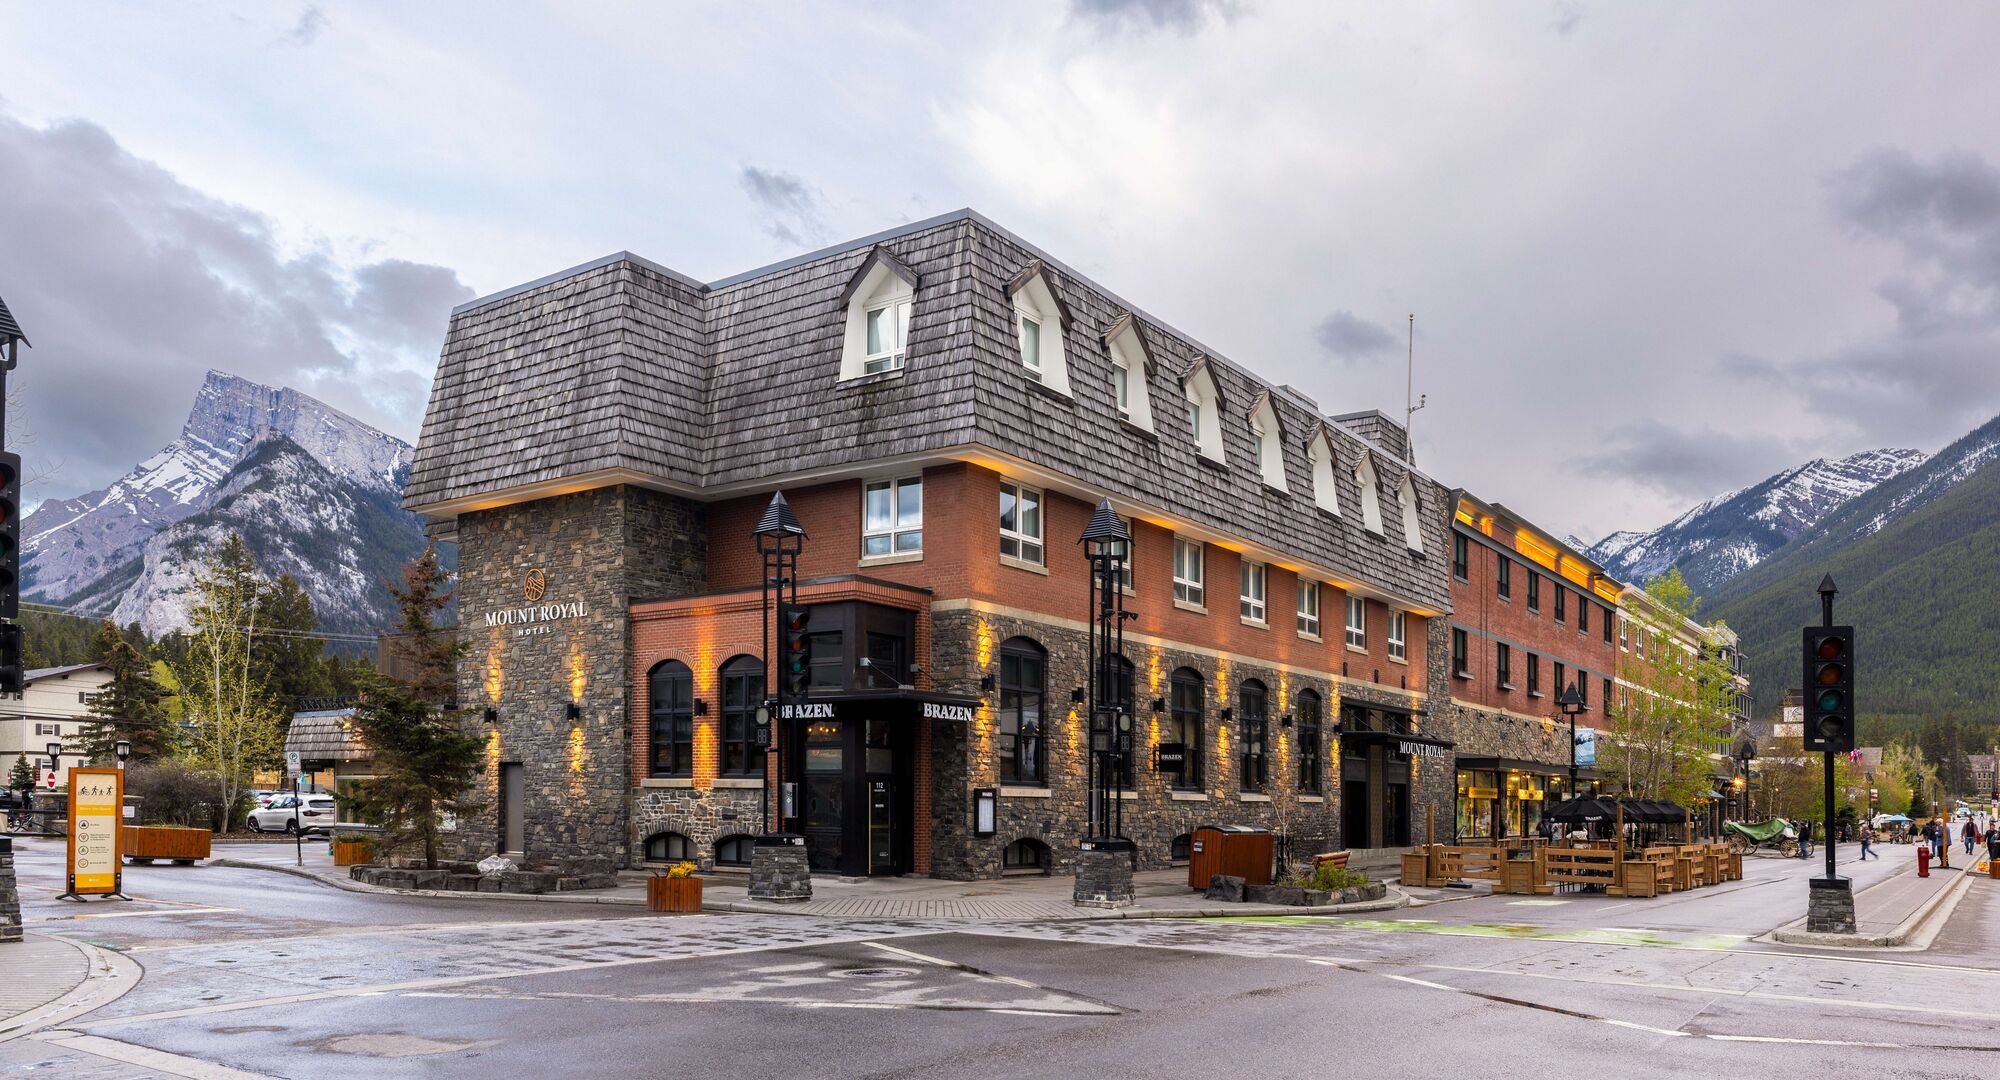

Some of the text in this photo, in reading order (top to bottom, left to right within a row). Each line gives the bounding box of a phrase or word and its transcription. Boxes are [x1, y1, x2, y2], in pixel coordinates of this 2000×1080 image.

[485, 601, 588, 627] MOUNT ROYAL
[518, 626, 551, 636] HOTEL
[1399, 741, 1445, 758] MOUNT ROYAL
